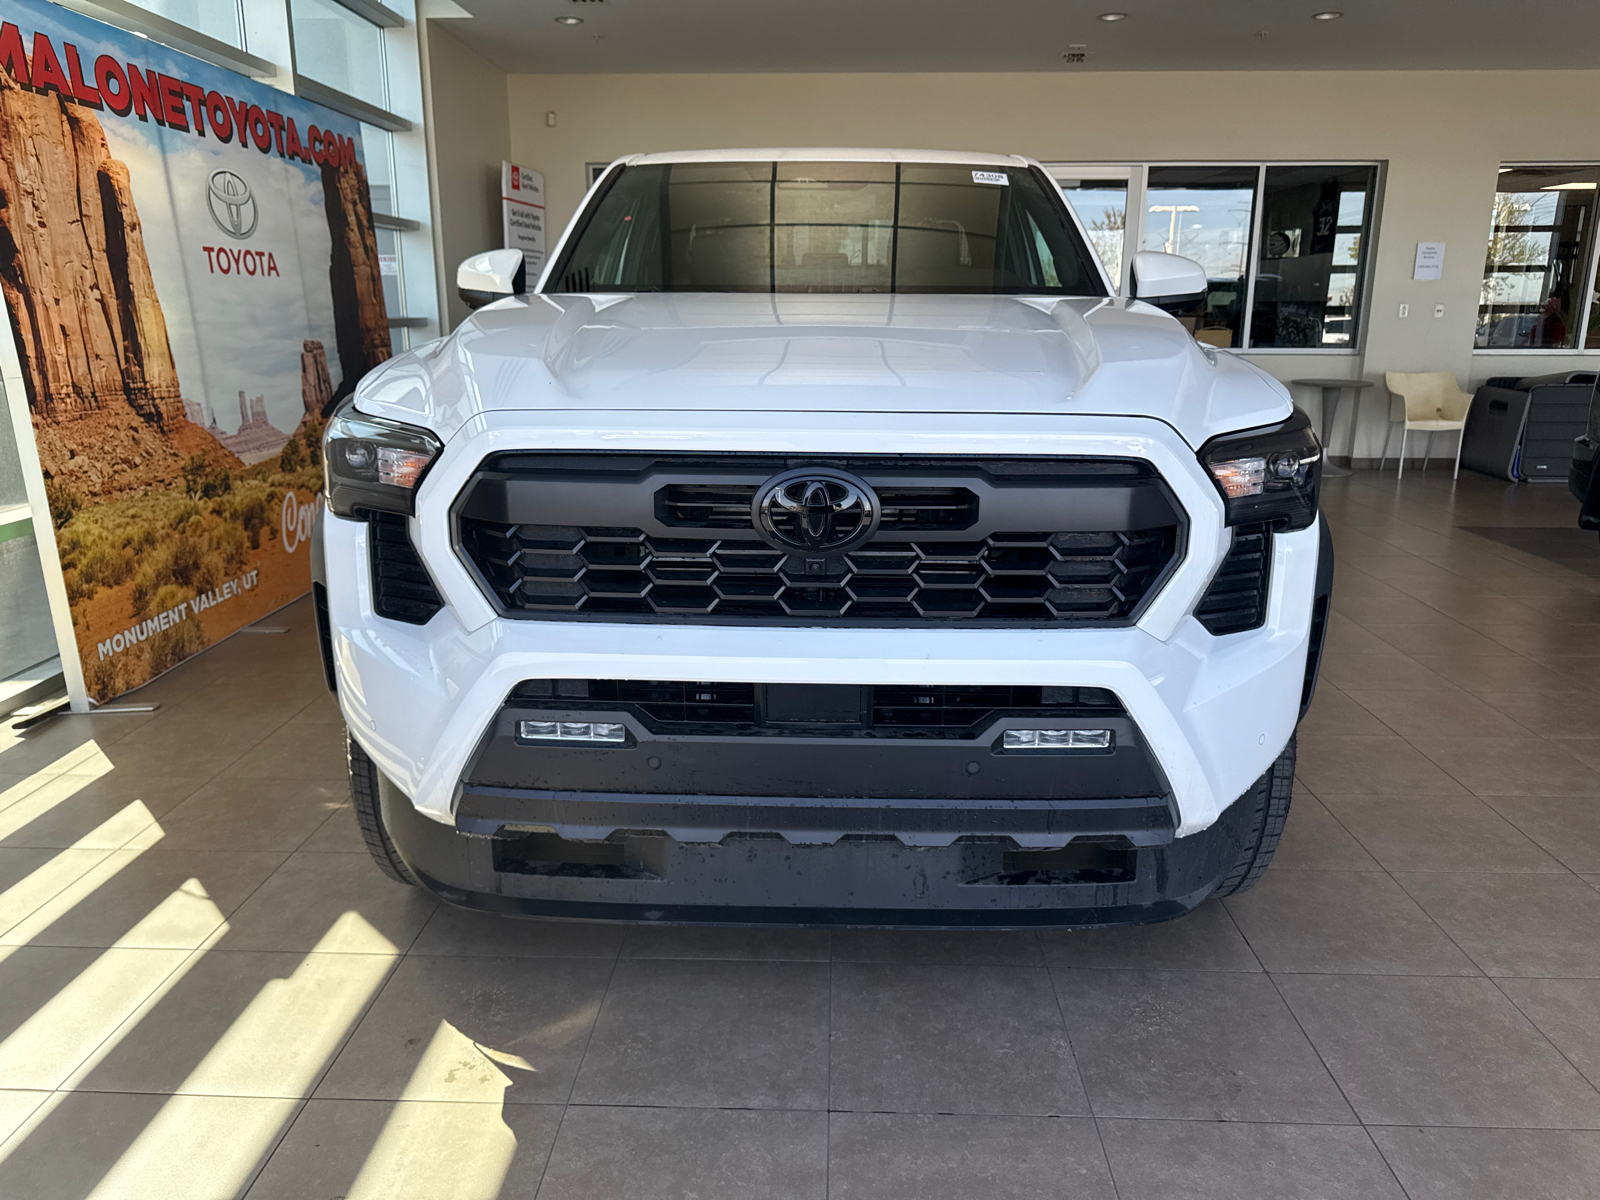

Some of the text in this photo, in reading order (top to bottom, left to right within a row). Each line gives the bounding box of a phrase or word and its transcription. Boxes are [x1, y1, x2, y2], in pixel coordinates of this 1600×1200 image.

[0, 21, 357, 171] MALONETOYOTA.COM
[202, 246, 280, 277] TOYOTA
[97, 569, 259, 662] MONUMENT VALLEY, UT
